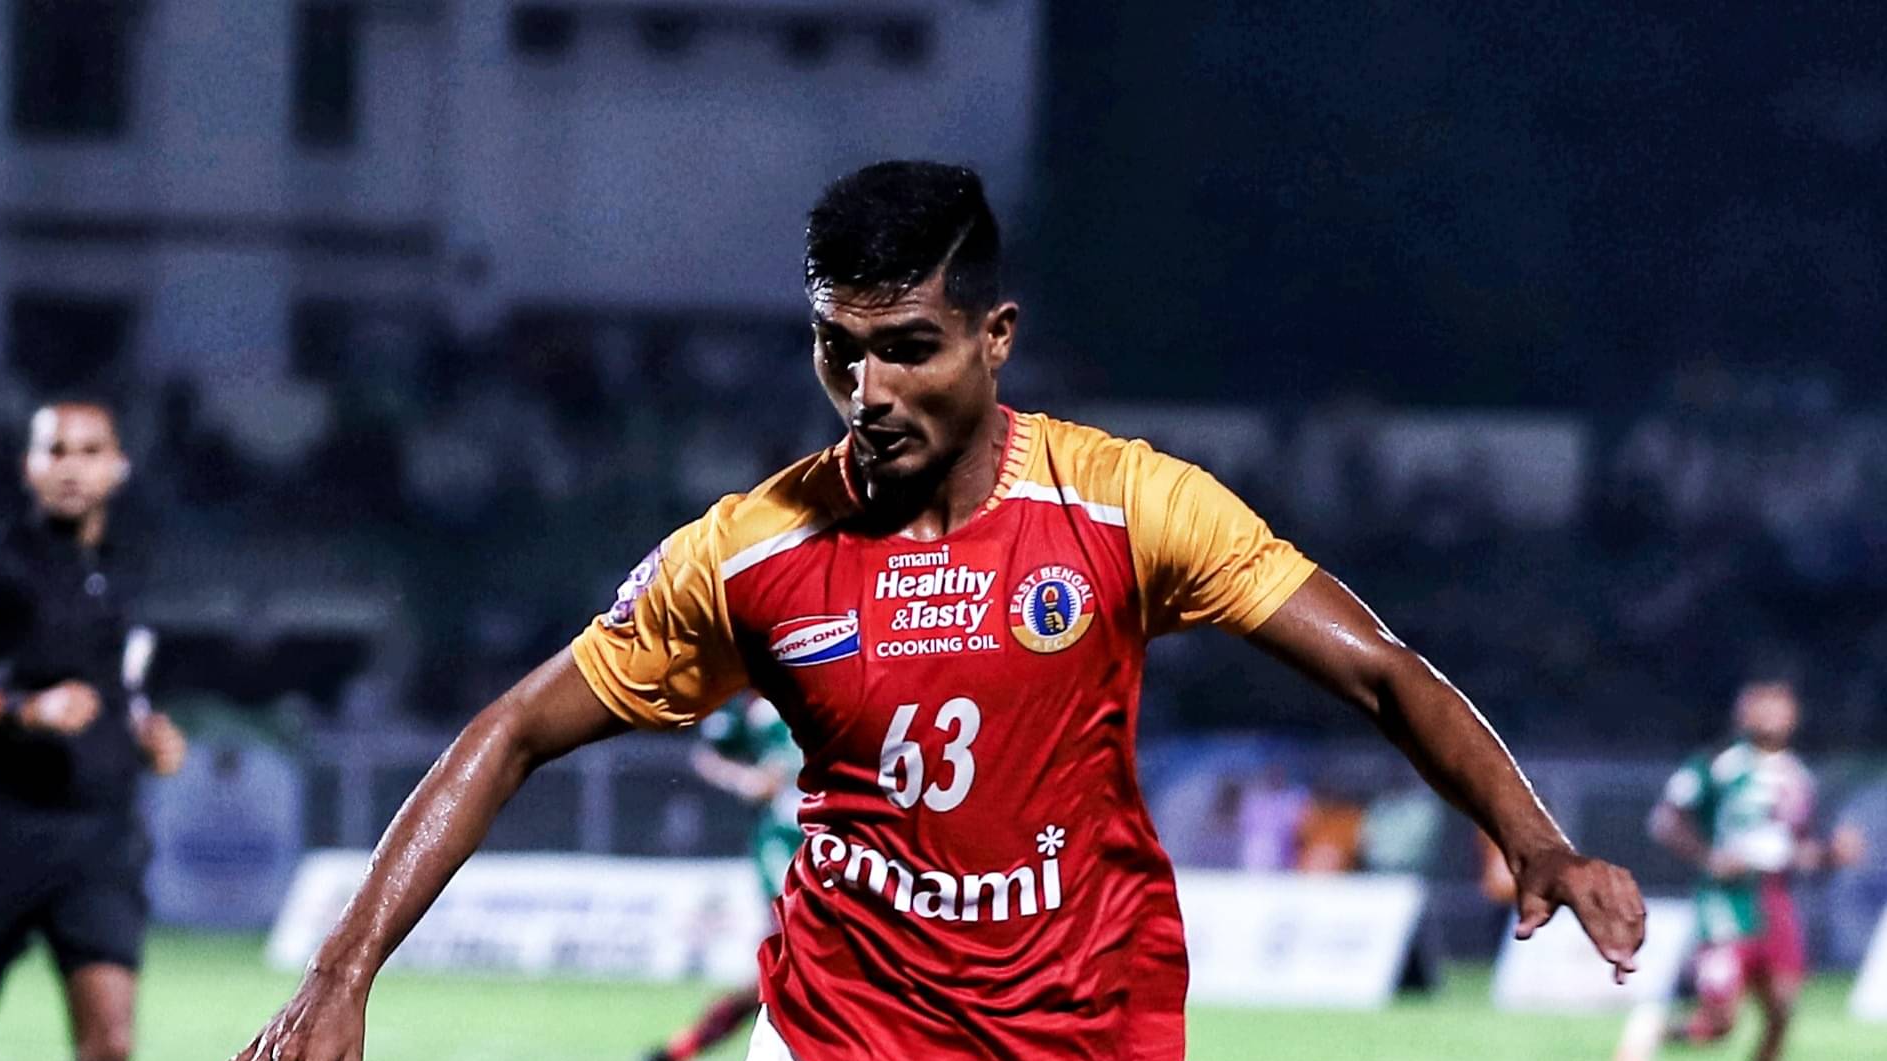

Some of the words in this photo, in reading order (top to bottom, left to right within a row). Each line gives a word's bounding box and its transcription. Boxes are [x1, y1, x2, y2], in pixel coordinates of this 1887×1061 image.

[888, 544, 950, 569] emami
[875, 565, 997, 601] Healthy
[1009, 574, 1037, 614] EAST
[1039, 566, 1094, 604] BENGAL
[876, 637, 963, 657] COOKING
[967, 635, 1001, 650] OIL
[877, 696, 982, 812] 63
